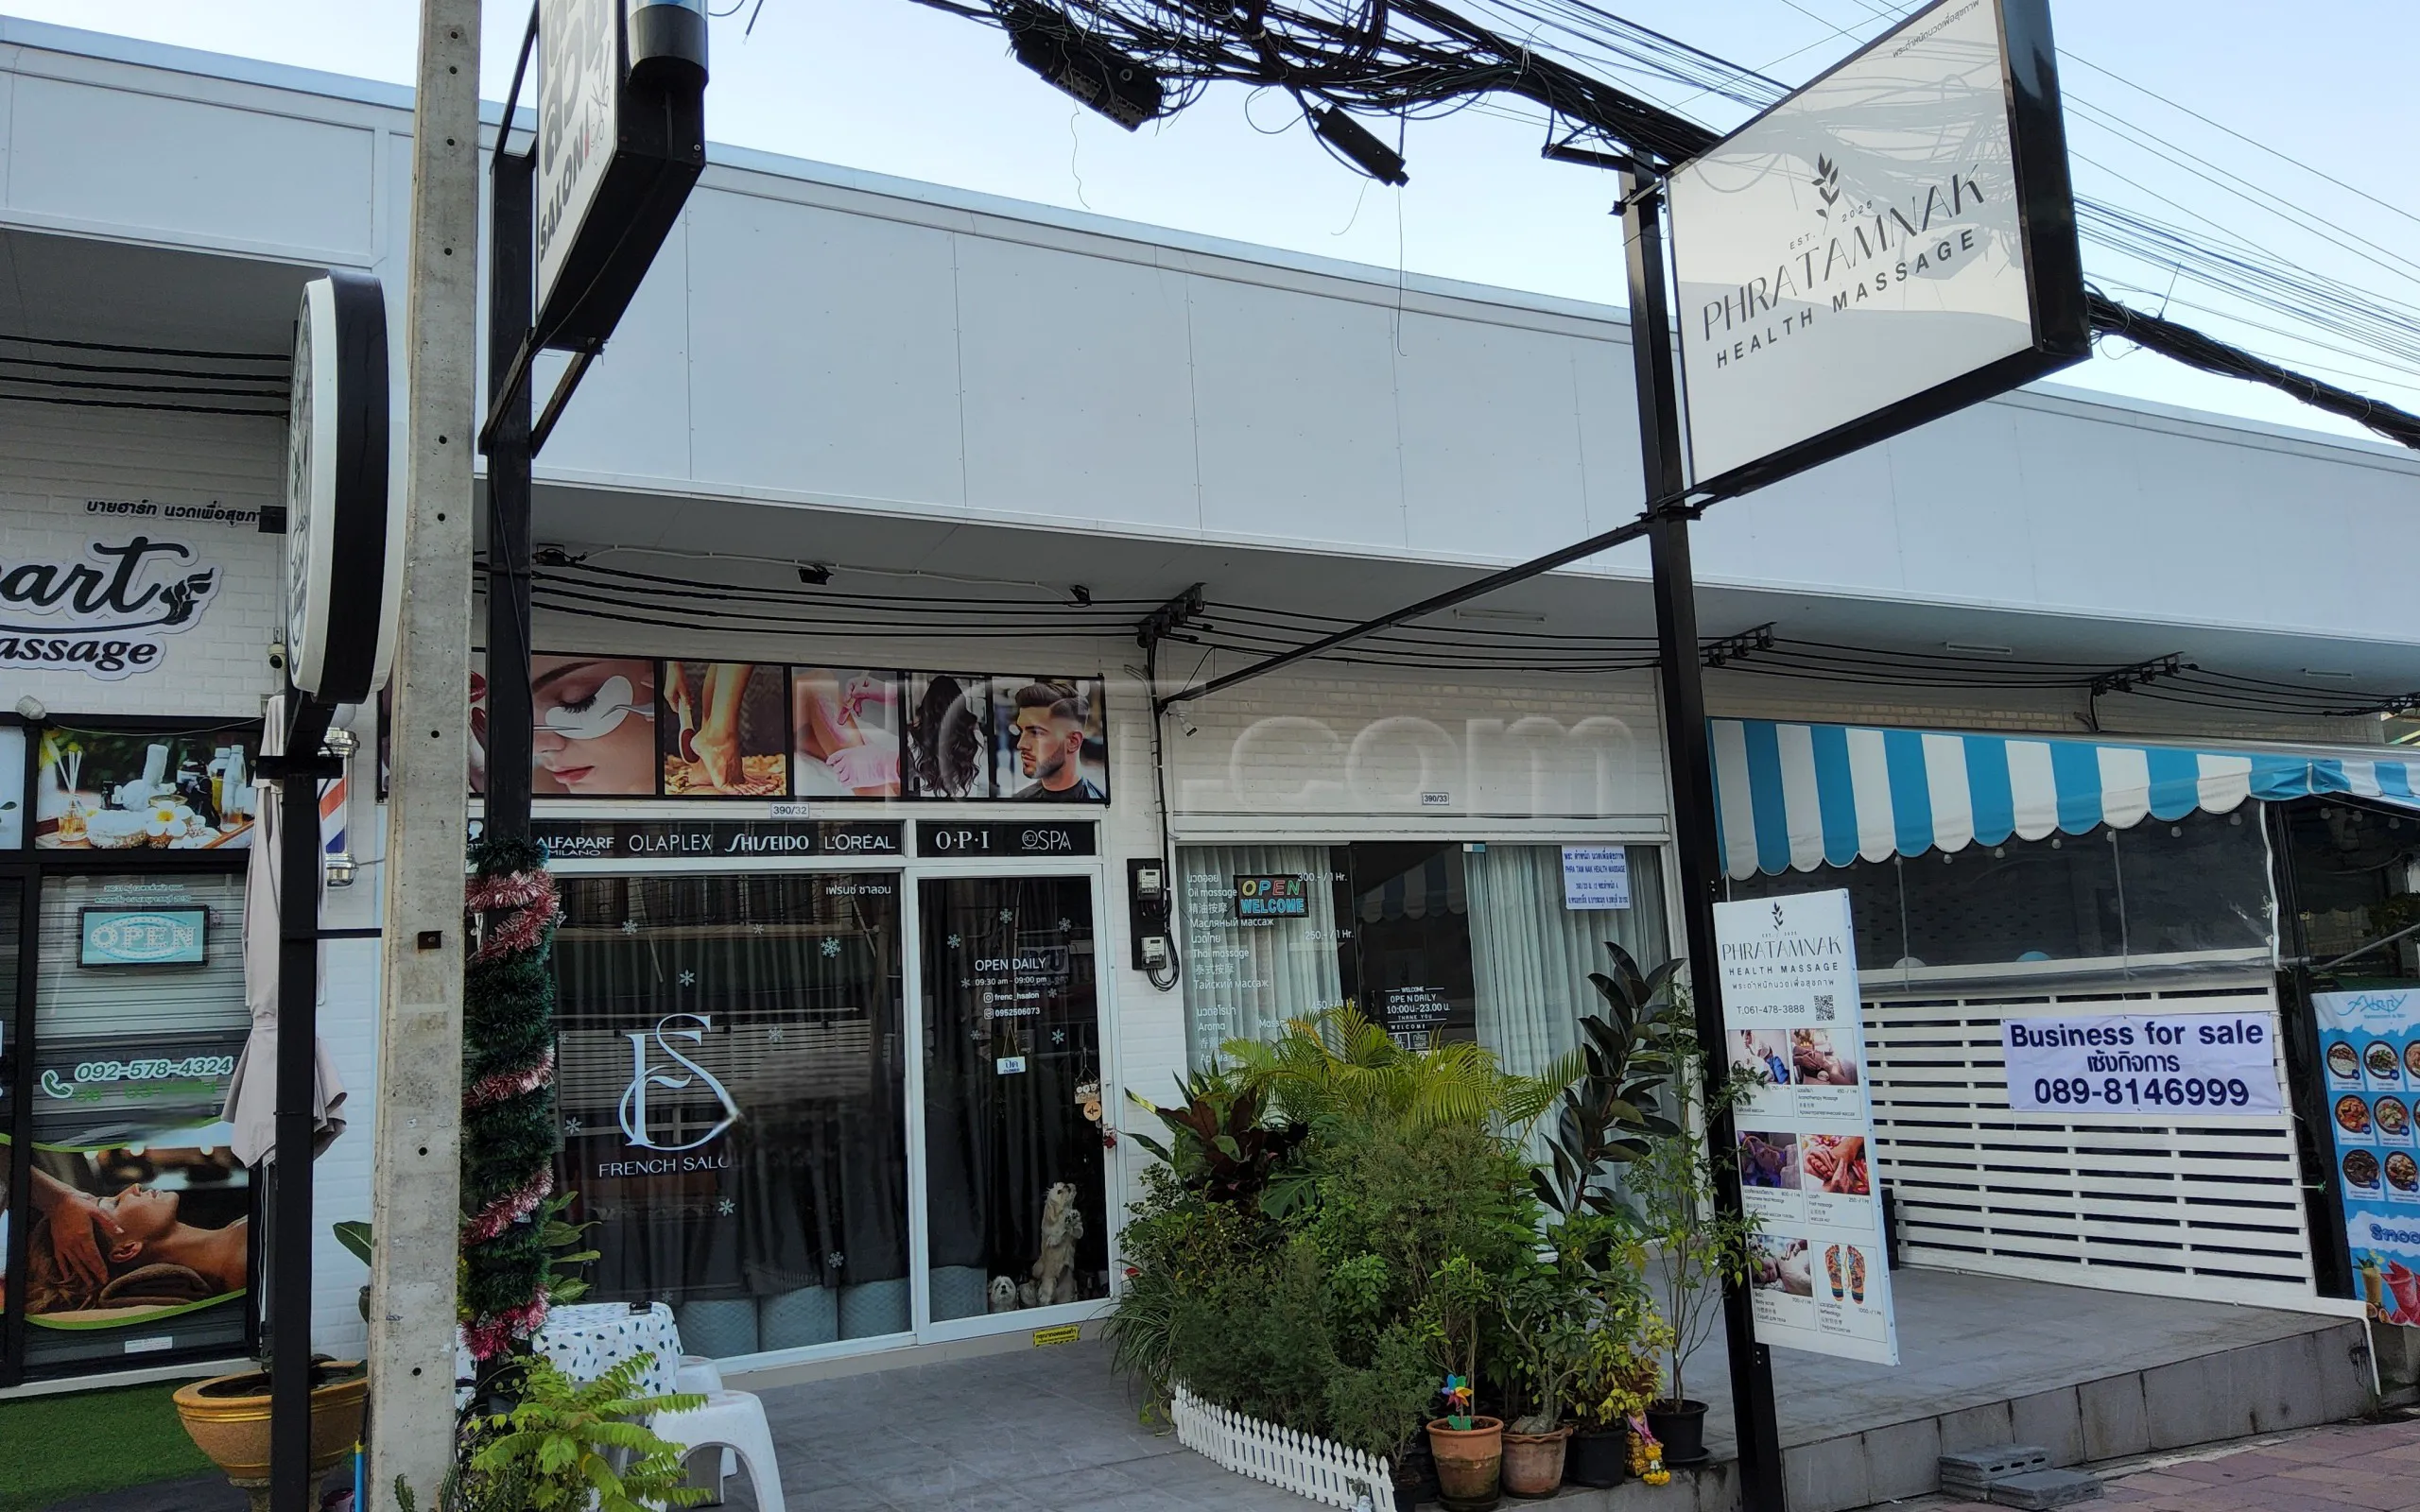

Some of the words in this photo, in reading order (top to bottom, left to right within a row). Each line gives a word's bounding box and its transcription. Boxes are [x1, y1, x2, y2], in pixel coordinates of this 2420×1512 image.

[540, 122, 583, 264] SALON
[1789, 234, 1817, 250] EST.
[1841, 199, 1874, 223] 2025
[1703, 163, 1985, 341] PHRATAMNAK
[1717, 307, 1814, 369] HEALTH
[1832, 229, 1975, 314] MASSAGE
[1424, 794, 1449, 804] 390/33
[773, 805, 807, 816] 390/32
[536, 836, 615, 849] ALFAPARF
[629, 834, 712, 851] OLAPLEX
[724, 833, 809, 851] SHISEIDO
[1038, 830, 1072, 850] SPA
[1187, 887, 1199, 898] Oil
[1200, 888, 1238, 900] massage
[1242, 880, 1301, 896] OPEN
[1240, 898, 1305, 913] WELCOME
[1240, 918, 1275, 927] массаж
[90, 925, 196, 948] OPEN
[1192, 948, 1211, 958] Thai
[1212, 950, 1250, 960] massage
[1721, 935, 1842, 961] PHRATAMNAK
[975, 958, 1009, 971] OPEN
[1012, 956, 1046, 971] DAILY
[1728, 966, 1774, 976] HEALTH
[1780, 962, 1839, 974] MASSAGE
[1014, 976, 1035, 985] 09:00
[1036, 977, 1047, 986] pm
[1235, 979, 1270, 988] массаж
[1198, 1022, 1226, 1032] Aroma
[2010, 1023, 2135, 1047] Business
[2144, 1022, 2187, 1045] for
[2199, 1020, 2264, 1045] sale
[76, 1057, 233, 1081] 092-578-4324
[2033, 1077, 2250, 1107] 089-8146999
[598, 1158, 677, 1178] FRENCH
